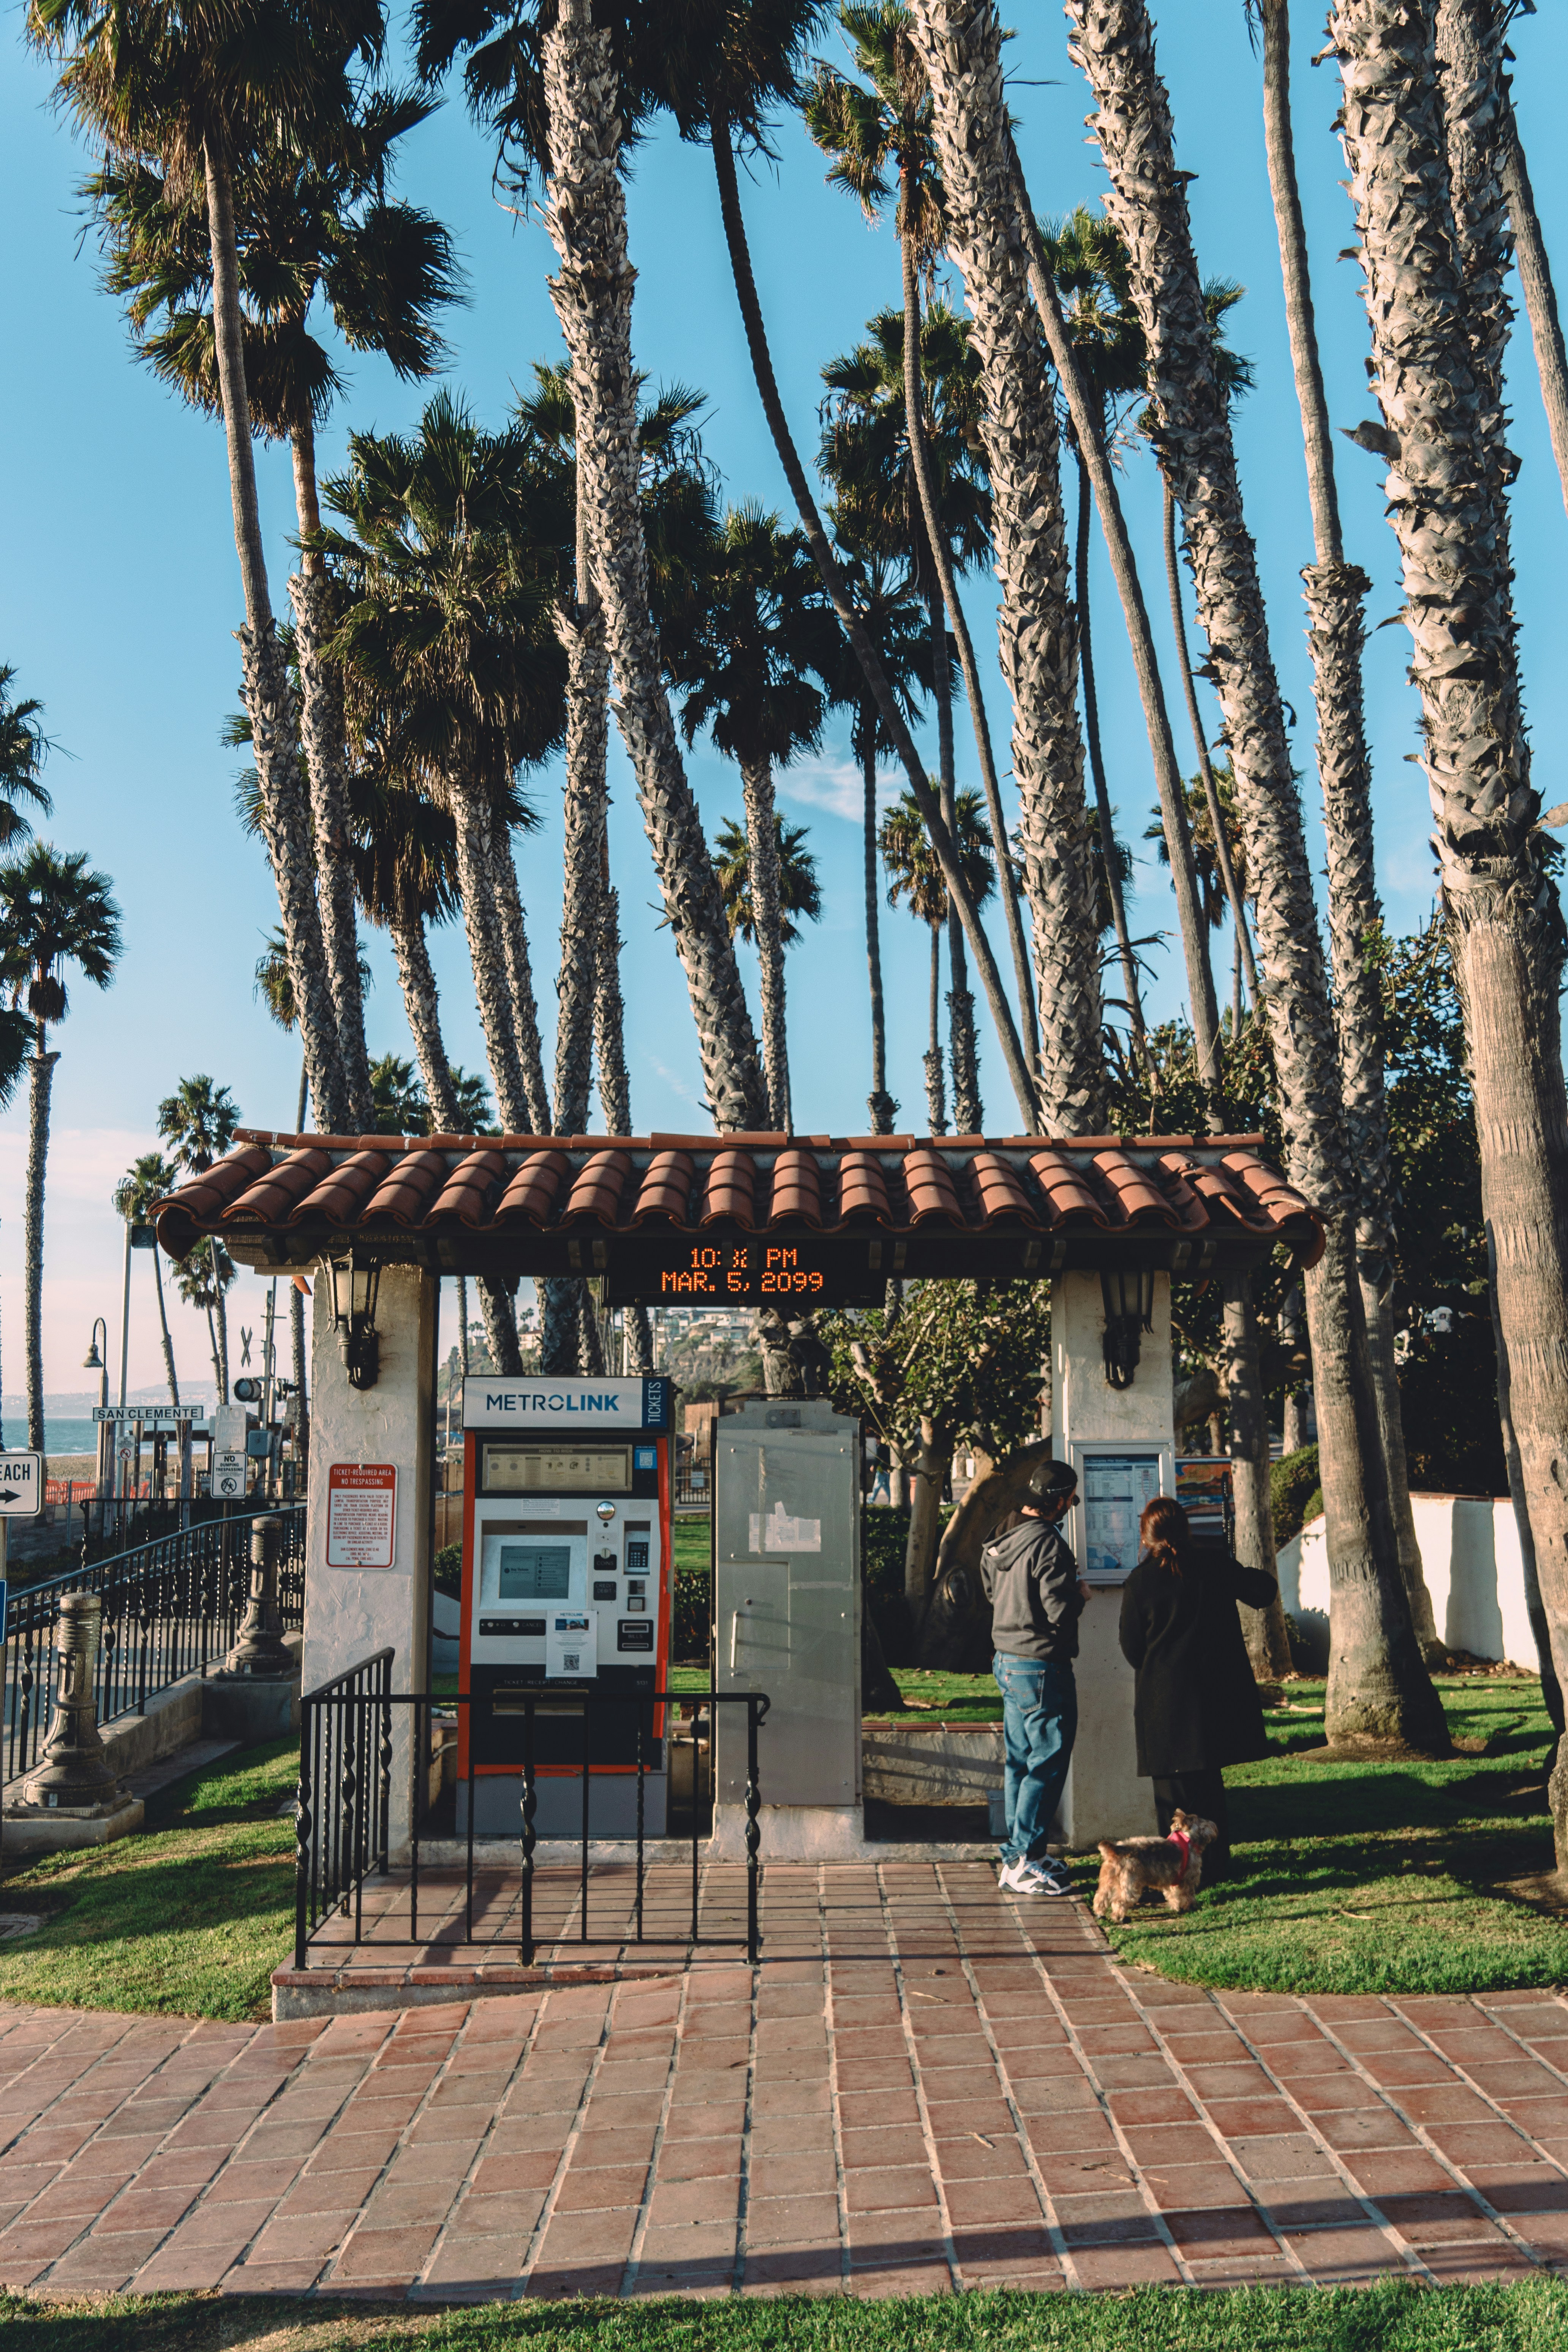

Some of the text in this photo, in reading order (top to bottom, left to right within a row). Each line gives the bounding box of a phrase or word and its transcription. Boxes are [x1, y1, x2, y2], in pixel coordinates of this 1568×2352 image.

[767, 1248, 797, 1268] PM
[662, 1272, 823, 1292] MAR. 5, 2099
[486, 1394, 620, 1411] METROLINK
[648, 1382, 661, 1423] TICKETS
[98, 1408, 198, 1419] SAN CLEMENTE
